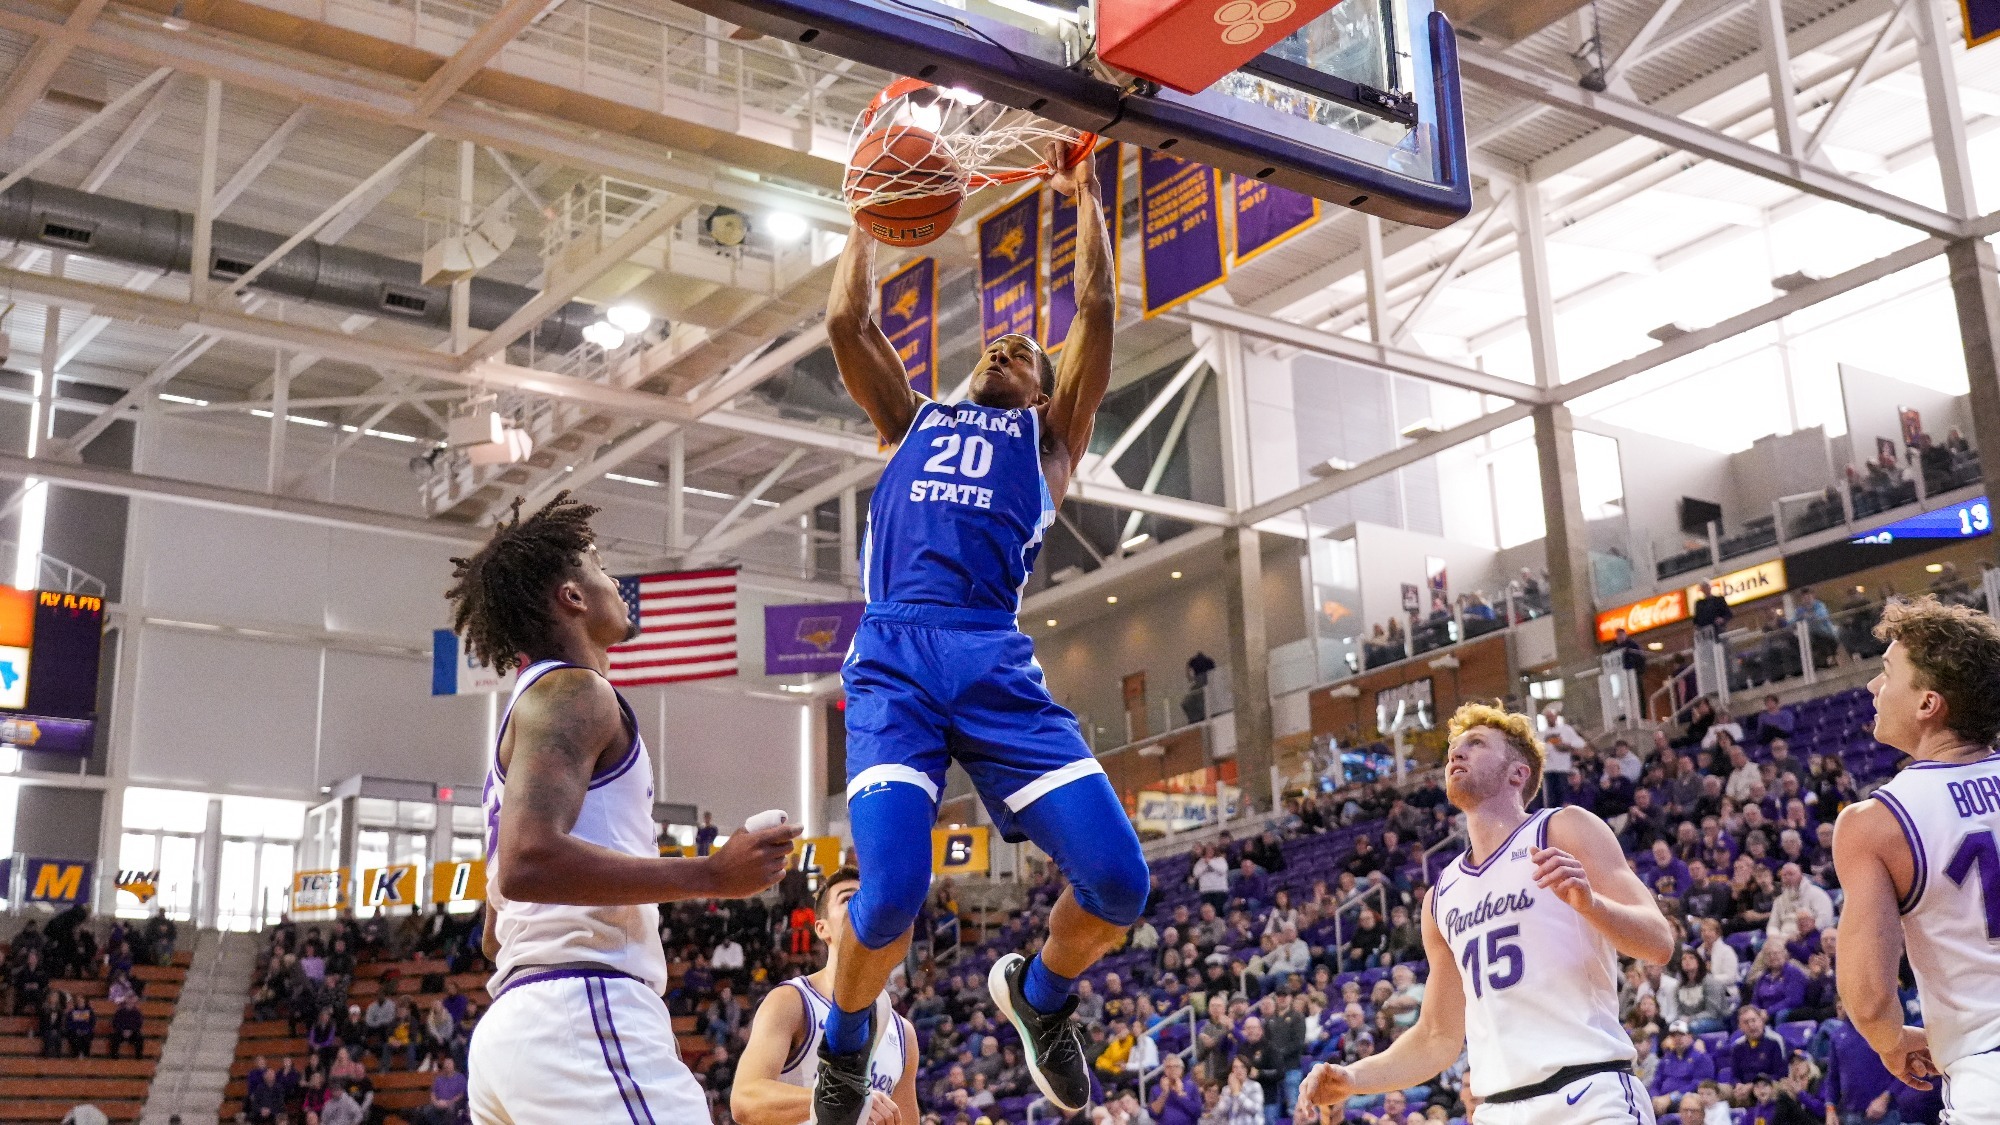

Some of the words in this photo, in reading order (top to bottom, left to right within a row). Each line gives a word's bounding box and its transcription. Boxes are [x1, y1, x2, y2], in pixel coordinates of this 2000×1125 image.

[917, 409, 1022, 438] INDIANA
[923, 433, 994, 479] 20
[909, 479, 994, 509] STATE
[1958, 503, 1990, 535] 13
[64, 594, 78, 609] FL
[79, 596, 101, 612] PTS
[943, 834, 973, 867] B
[32, 863, 84, 900] M
[369, 867, 408, 906] K
[1445, 888, 1535, 945] Panthers
[1461, 922, 1525, 1000] 15
